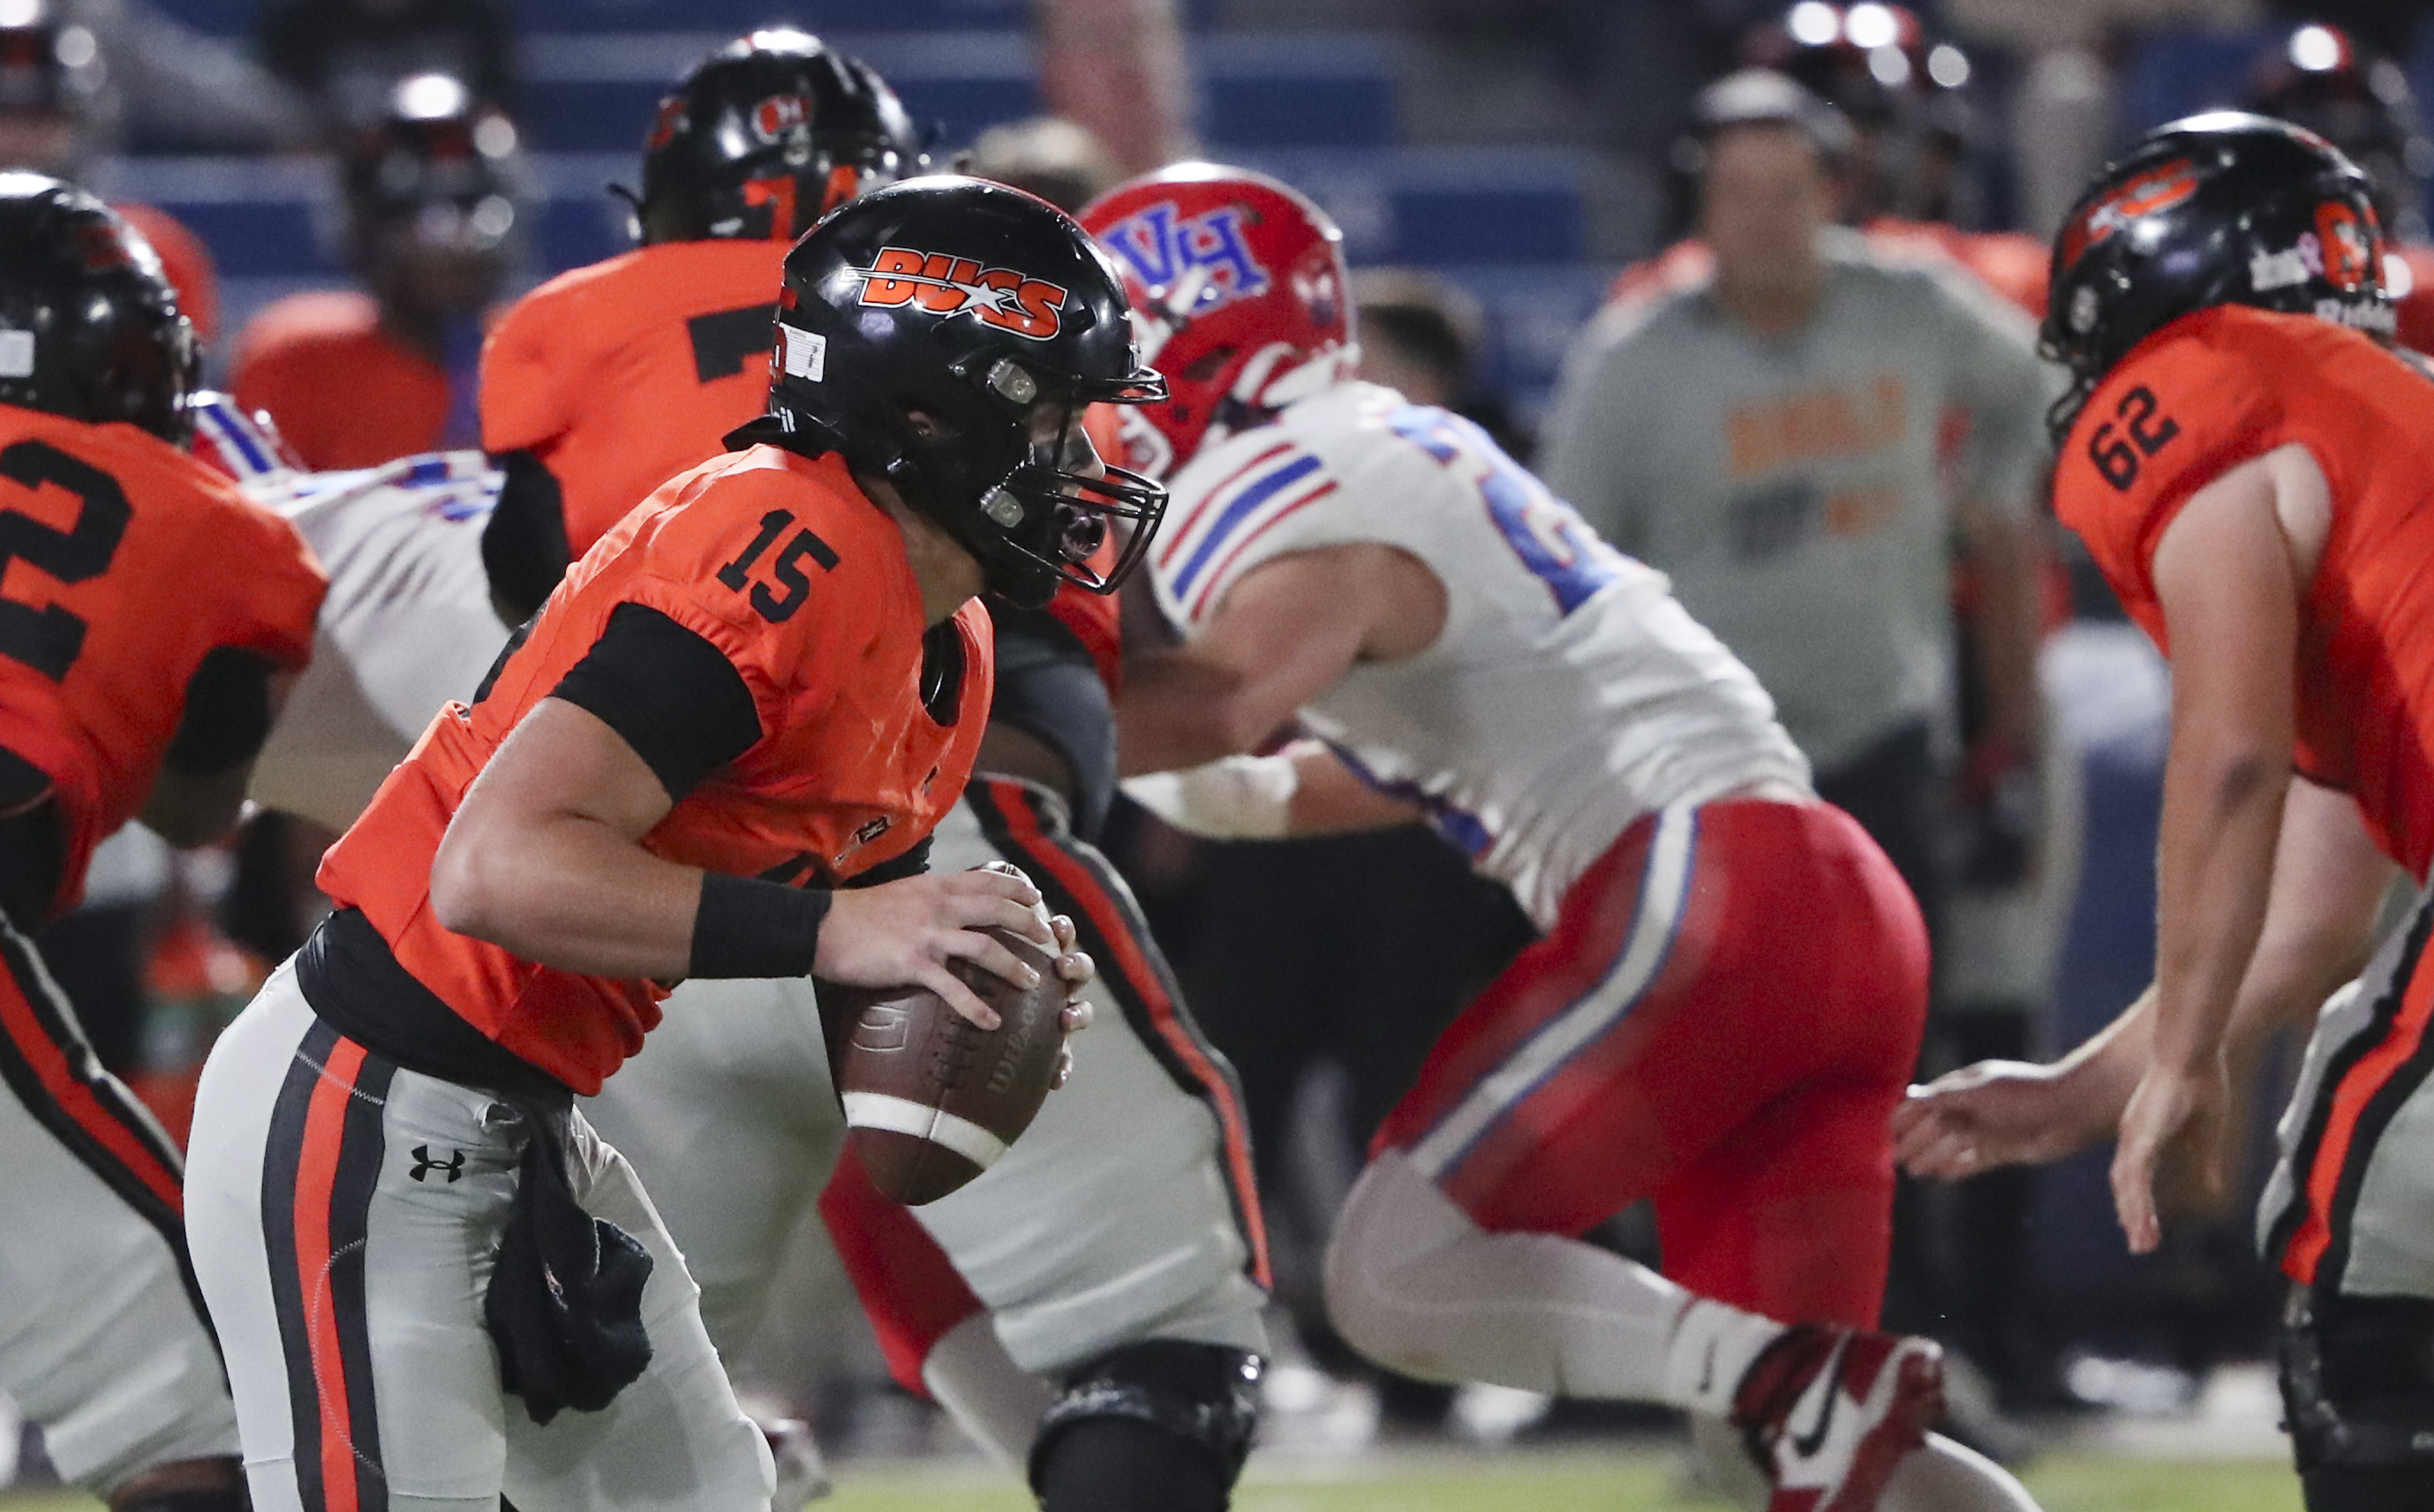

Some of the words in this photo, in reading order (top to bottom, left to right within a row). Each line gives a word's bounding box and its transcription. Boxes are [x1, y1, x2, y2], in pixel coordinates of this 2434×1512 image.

[855, 246, 1069, 342] BUCS
[1102, 202, 1270, 316] VH
[2089, 385, 2182, 493] 62
[716, 508, 841, 623] 15
